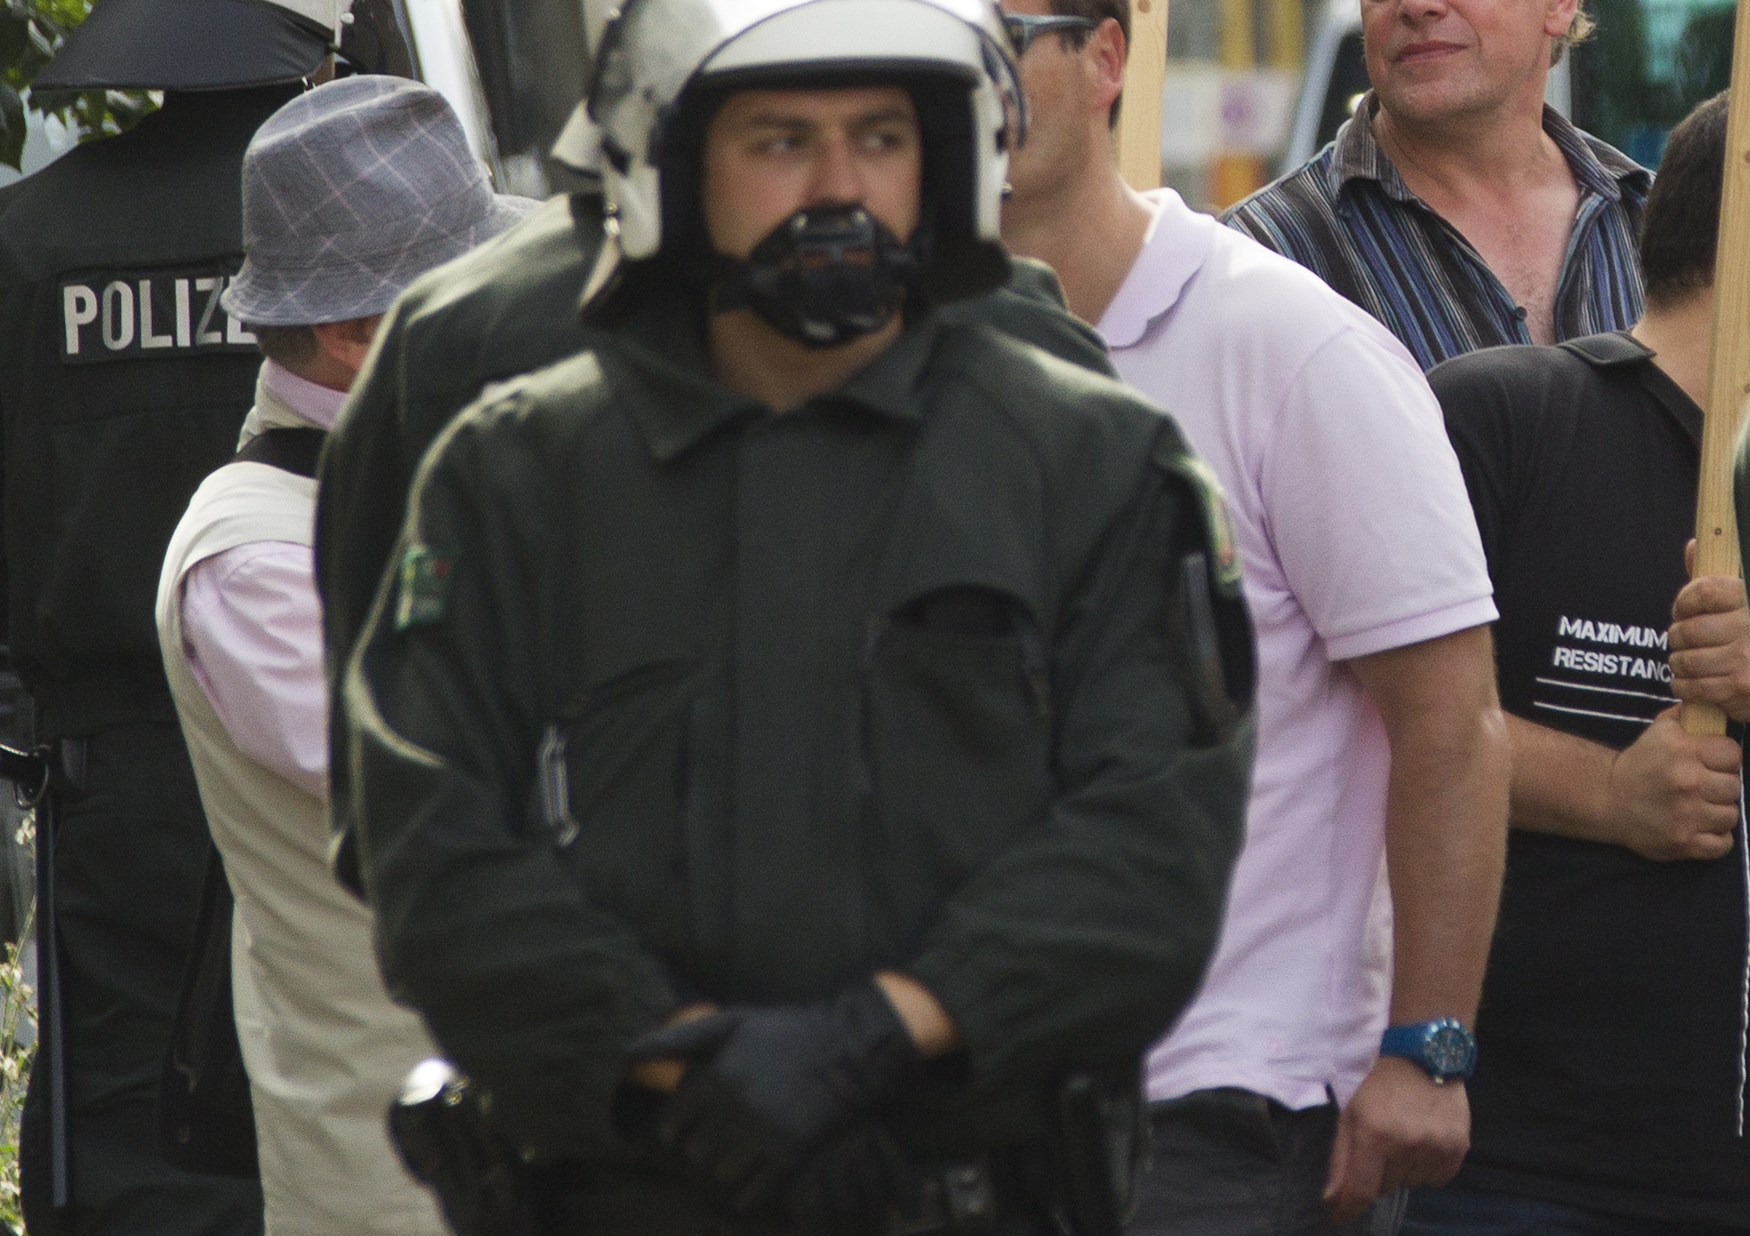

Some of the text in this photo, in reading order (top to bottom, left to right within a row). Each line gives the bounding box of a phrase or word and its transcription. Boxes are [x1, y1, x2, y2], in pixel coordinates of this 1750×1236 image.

[63, 275, 258, 355] POLIZE
[1558, 615, 1669, 651] MAXIMUM
[1553, 646, 1675, 683] RESISTANC
